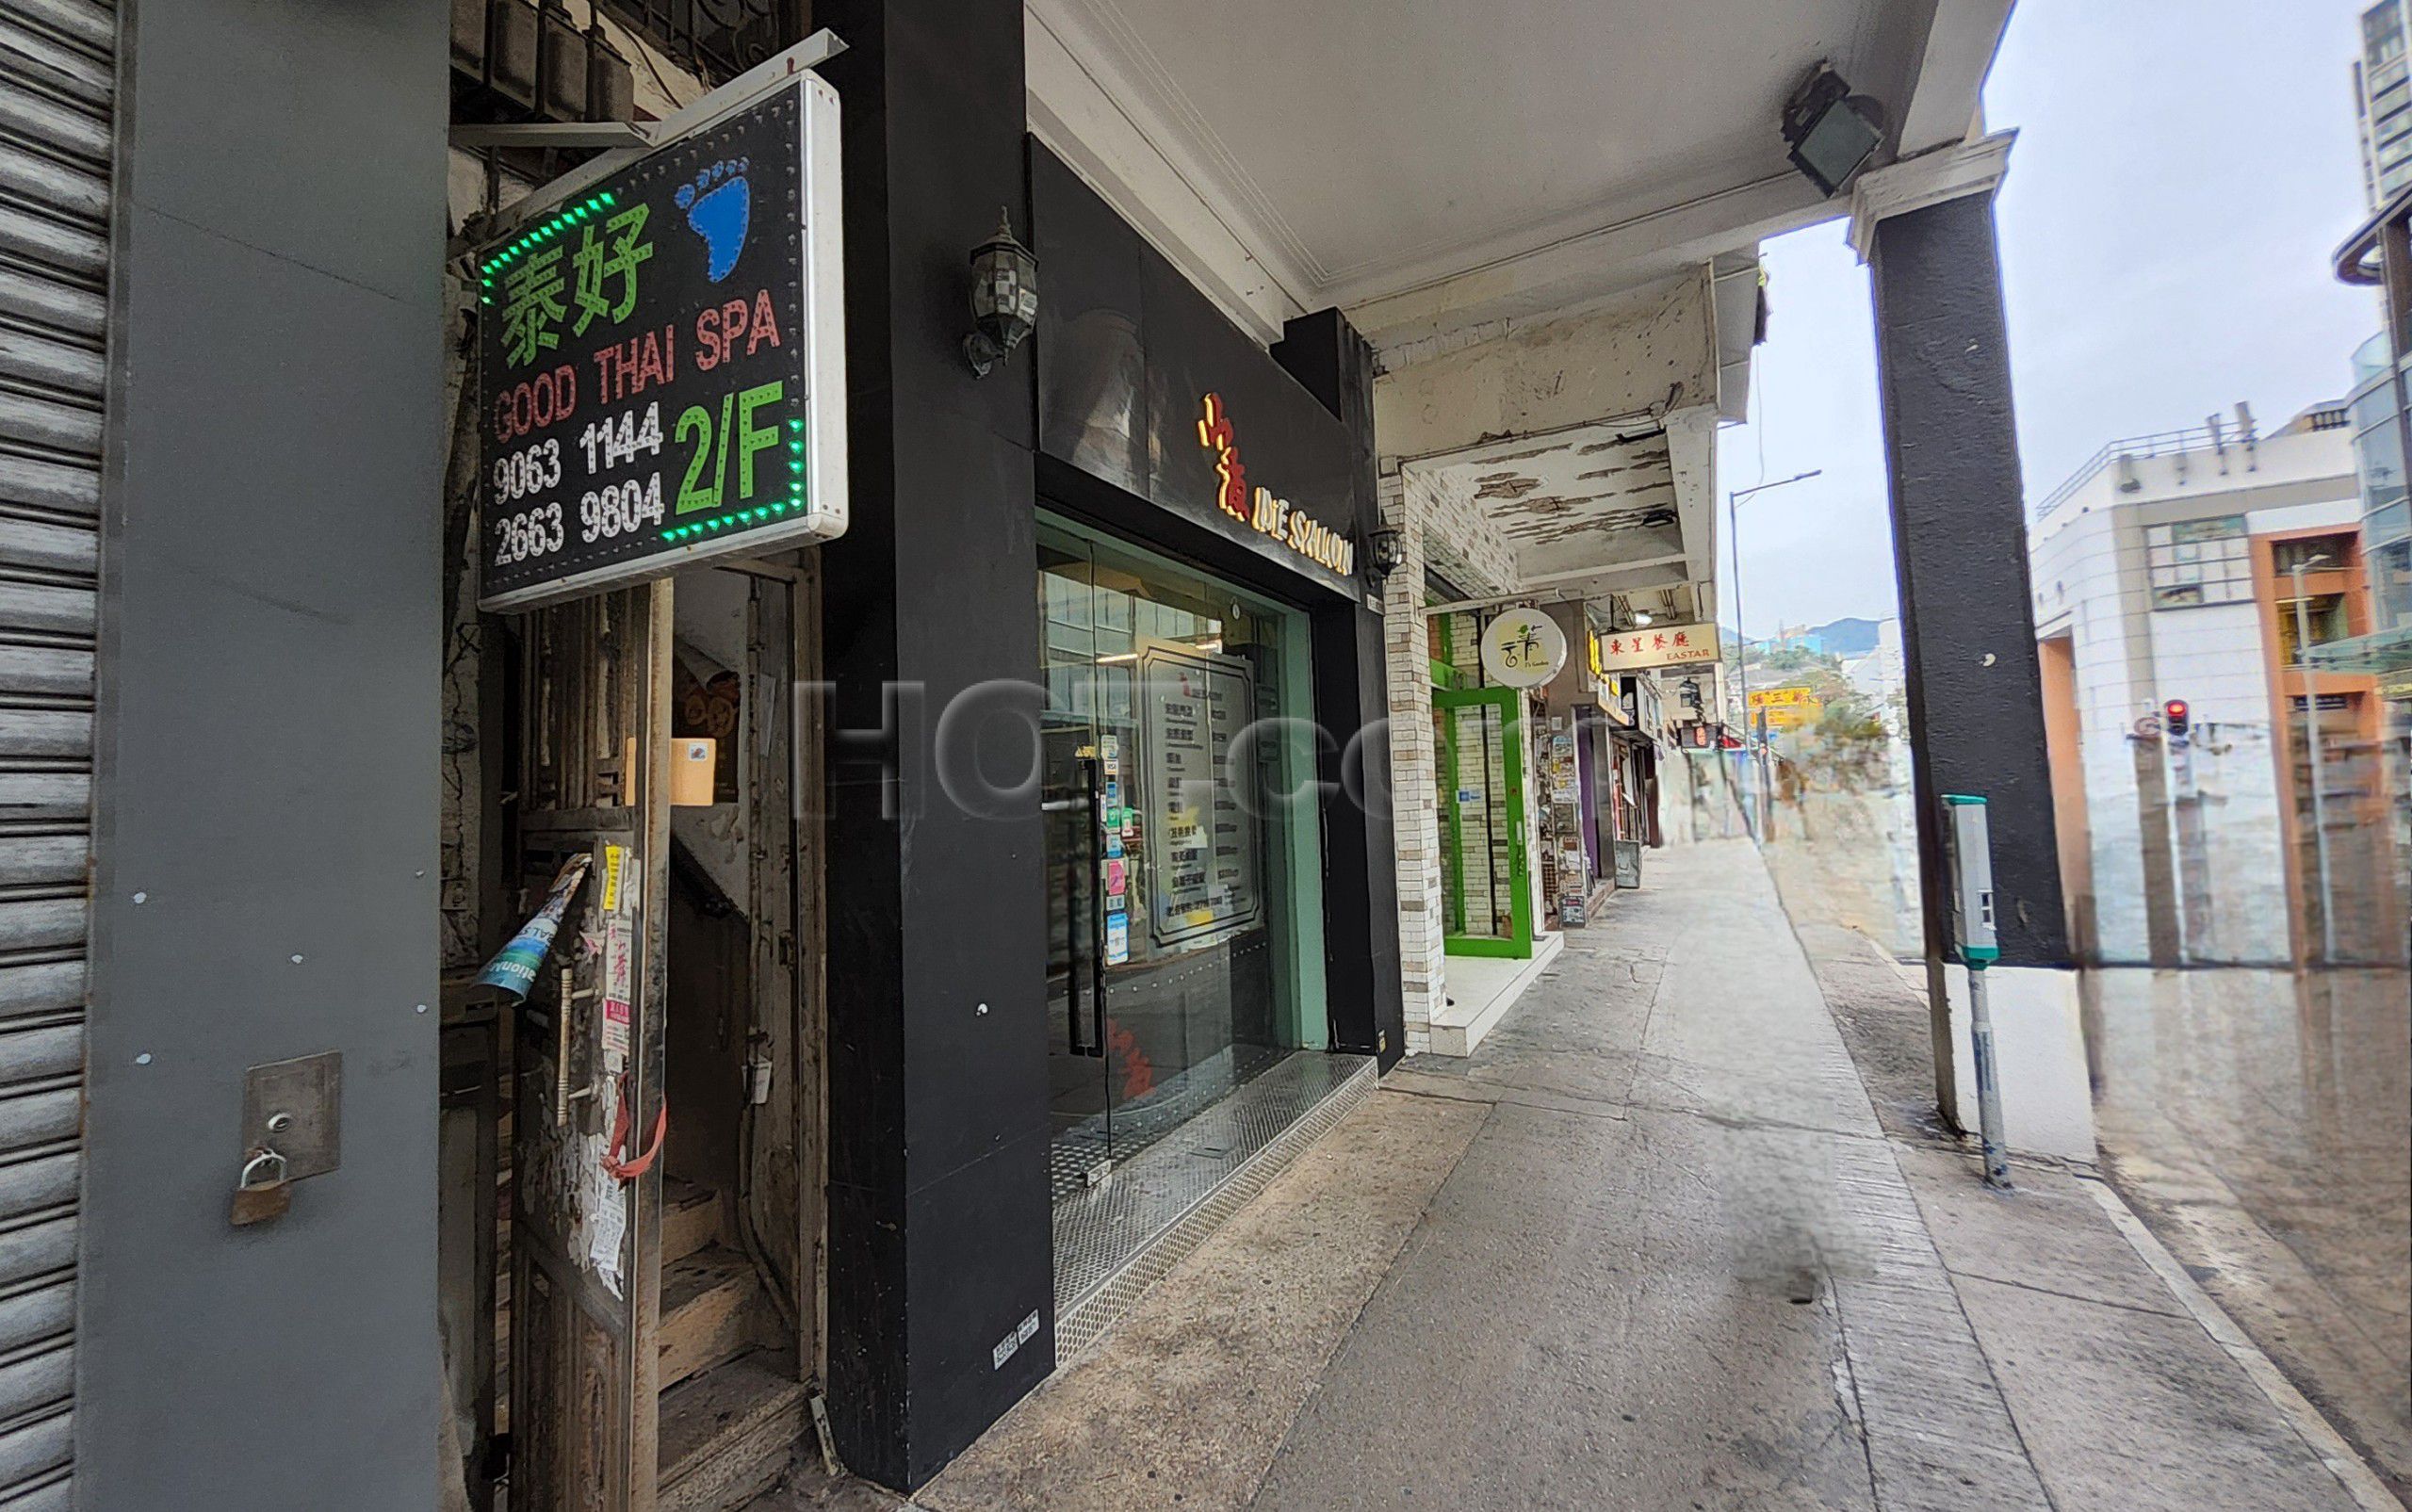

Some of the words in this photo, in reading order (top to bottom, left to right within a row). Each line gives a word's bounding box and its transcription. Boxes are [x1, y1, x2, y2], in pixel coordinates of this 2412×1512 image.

[498, 202, 654, 368] 泰好
[495, 364, 576, 444] GOOD
[594, 324, 674, 404] THAI
[695, 288, 781, 371] SPA
[494, 438, 562, 505] 9063
[579, 400, 663, 475] 1144
[675, 380, 783, 515] 2/F
[495, 502, 563, 566] 2663
[579, 472, 664, 543] 9804
[1288, 510, 1353, 577] SALON
[1611, 631, 1689, 655] 東星餐廳
[1666, 649, 1710, 660] EASTAR
